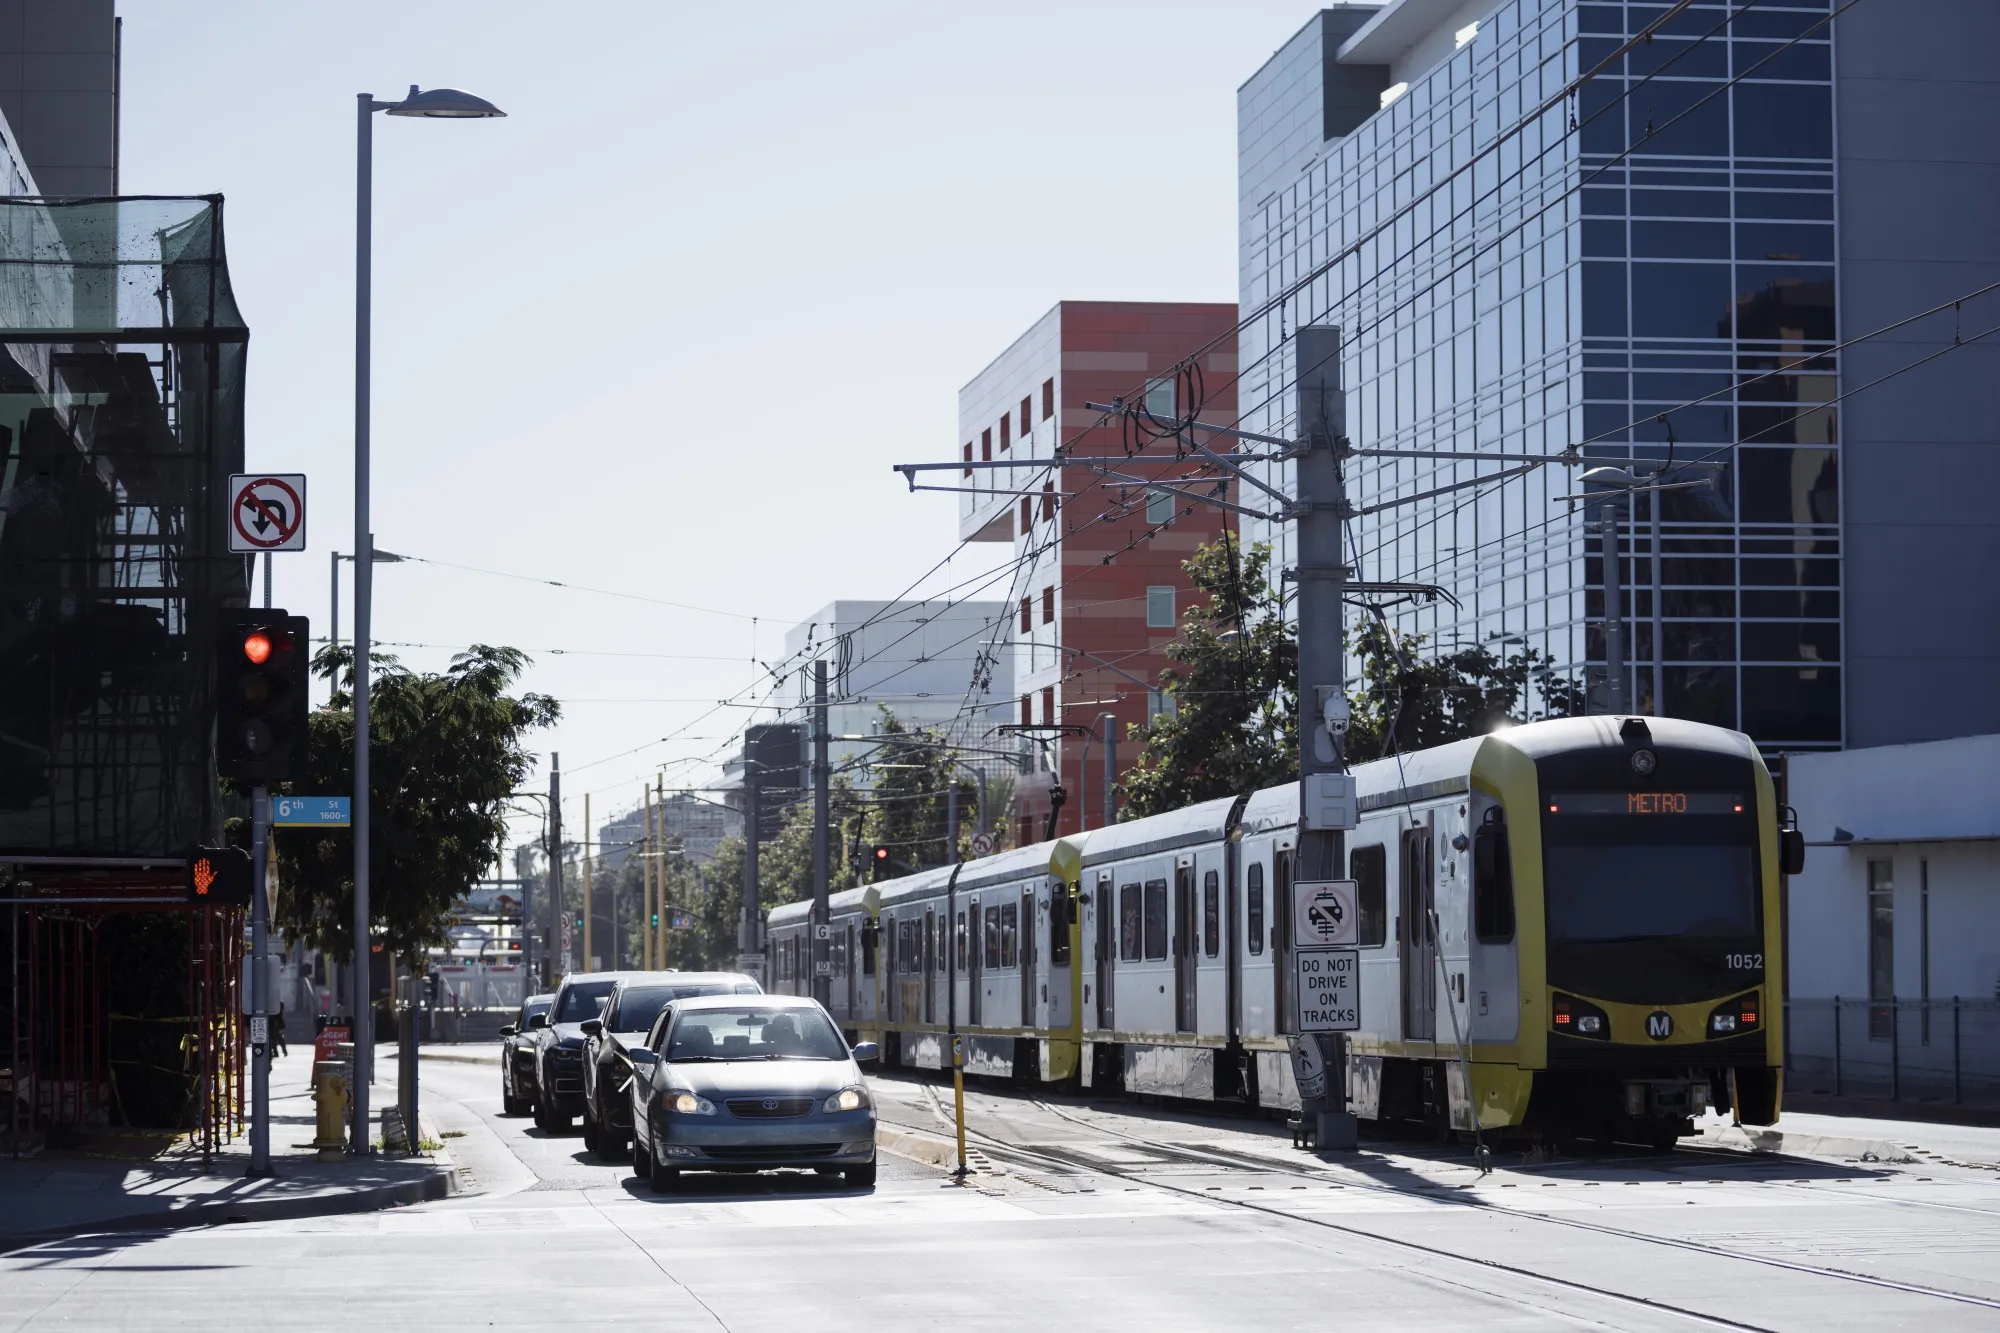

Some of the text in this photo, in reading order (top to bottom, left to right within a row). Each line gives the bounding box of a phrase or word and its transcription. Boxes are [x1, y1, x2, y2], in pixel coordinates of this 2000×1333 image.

[279, 800, 339, 817] 6th St
[1628, 793, 1687, 813] METRO
[320, 811, 341, 820] 1600
[818, 926, 827, 938] G
[1302, 959, 1353, 972] DO NOT
[1725, 954, 1763, 969] 1052
[1308, 976, 1347, 989] DRIVE
[1319, 993, 1338, 1005] ON
[1302, 1009, 1355, 1023] TRACKS
[1650, 1016, 1669, 1036] M
[319, 1031, 348, 1039] RGENT
